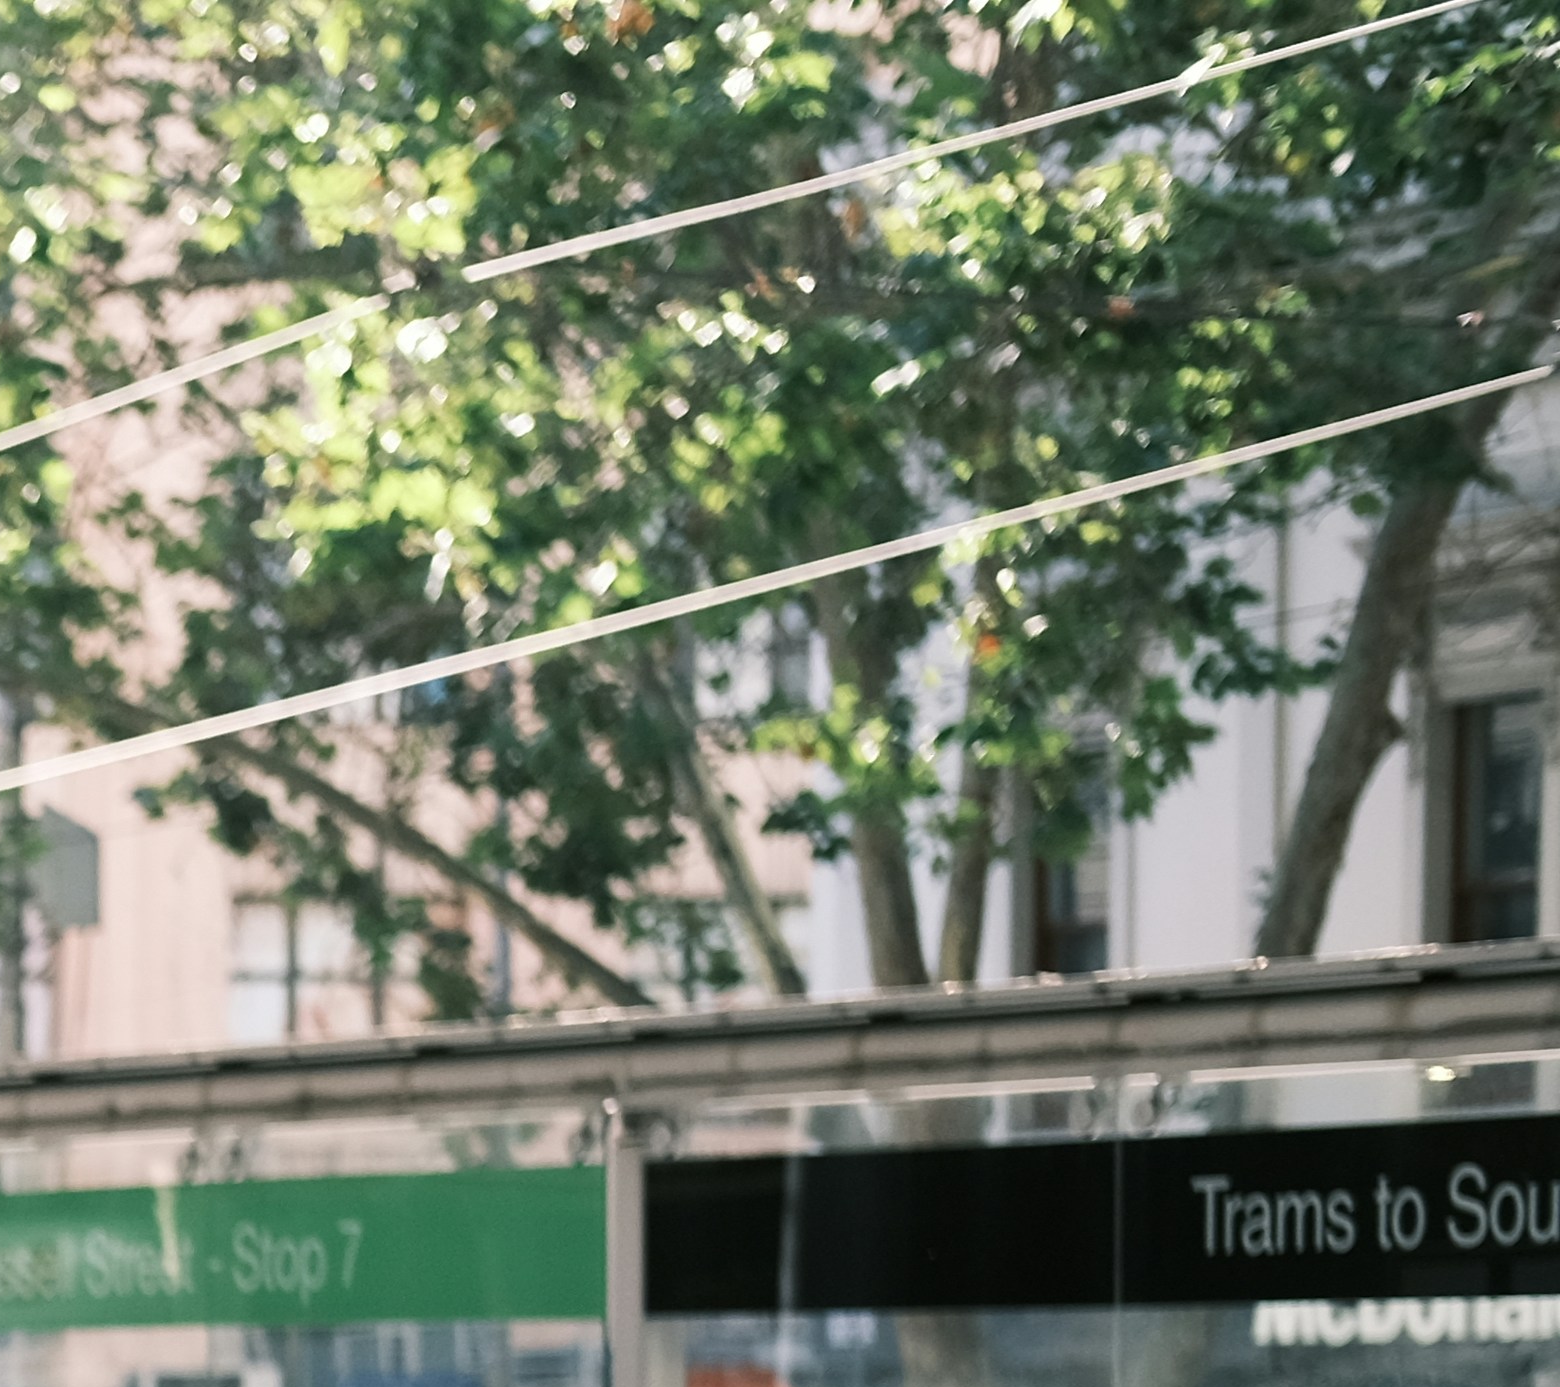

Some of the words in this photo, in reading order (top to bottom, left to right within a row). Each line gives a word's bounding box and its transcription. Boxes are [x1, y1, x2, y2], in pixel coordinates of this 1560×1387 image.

[1189, 1172, 1356, 1257] Trams
[1374, 1174, 1427, 1250] to
[231, 1219, 328, 1305] Stop
[337, 1216, 363, 1289] 7
